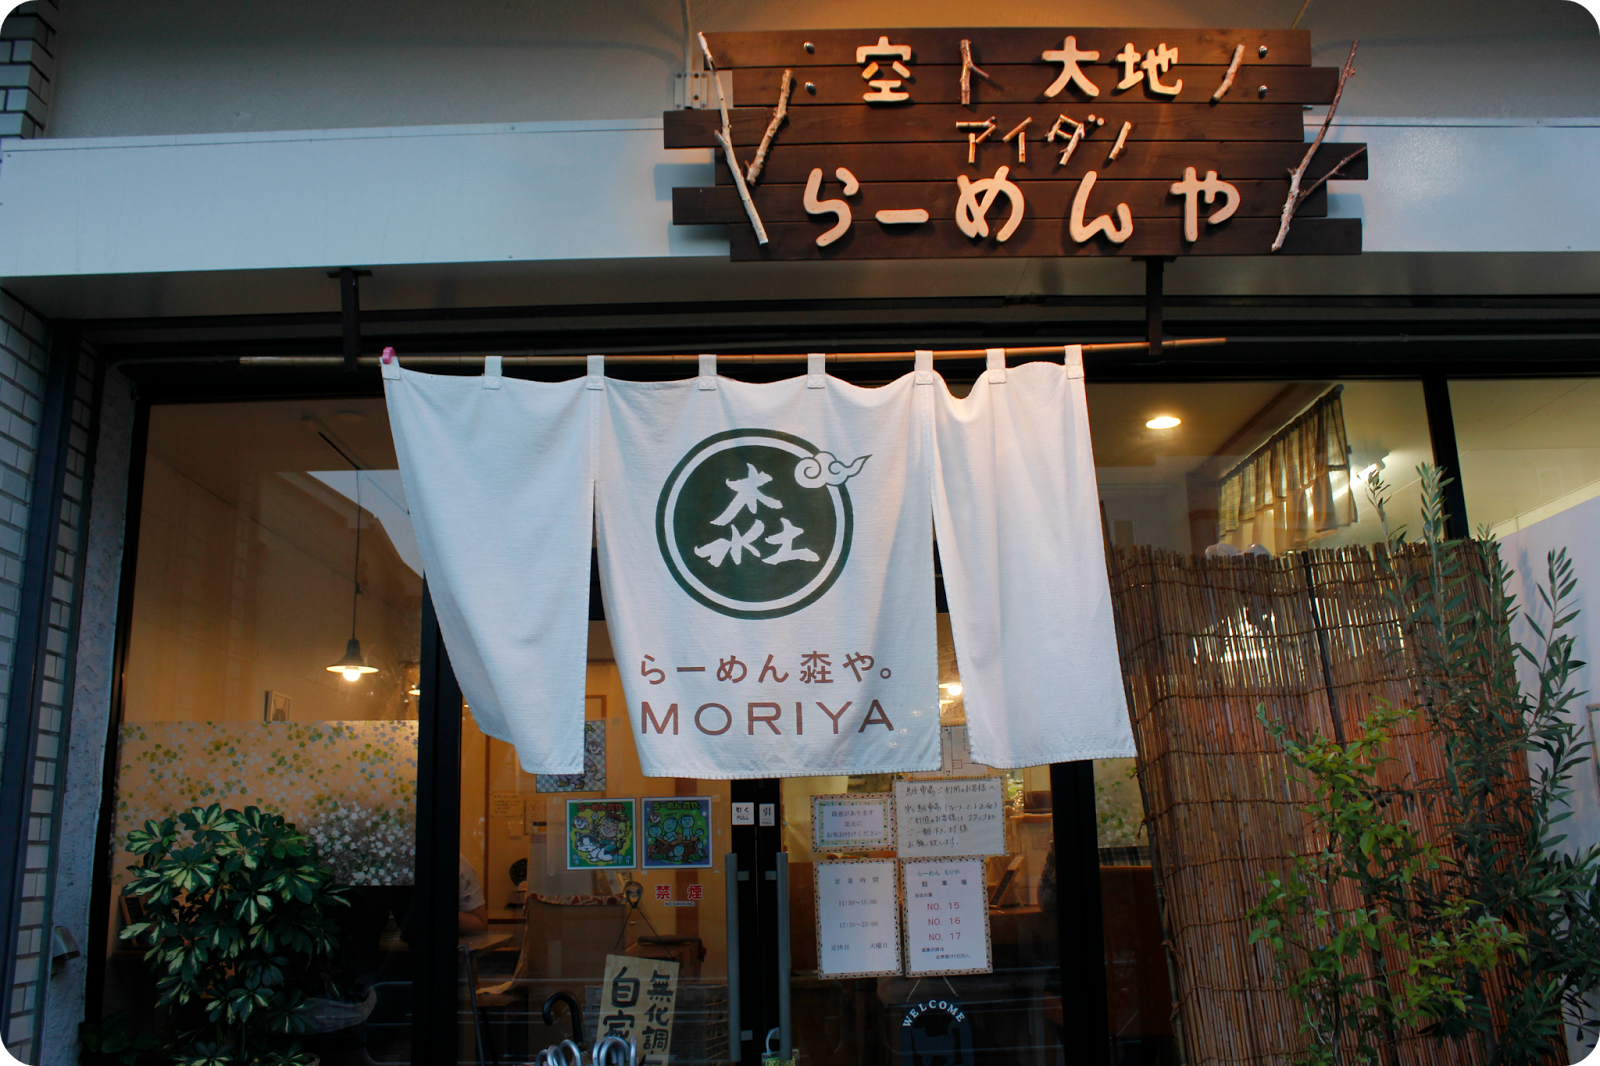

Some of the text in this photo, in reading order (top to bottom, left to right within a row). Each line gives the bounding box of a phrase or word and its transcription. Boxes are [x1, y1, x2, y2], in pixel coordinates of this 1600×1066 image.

[803, 166, 1241, 248] らーめんや
[641, 699, 896, 736] MORIYA
[655, 884, 703, 900] 禁煙
[948, 901, 960, 910] 15
[949, 917, 961, 925] 16
[950, 932, 961, 940] 17
[902, 999, 966, 1027] WELCOME
